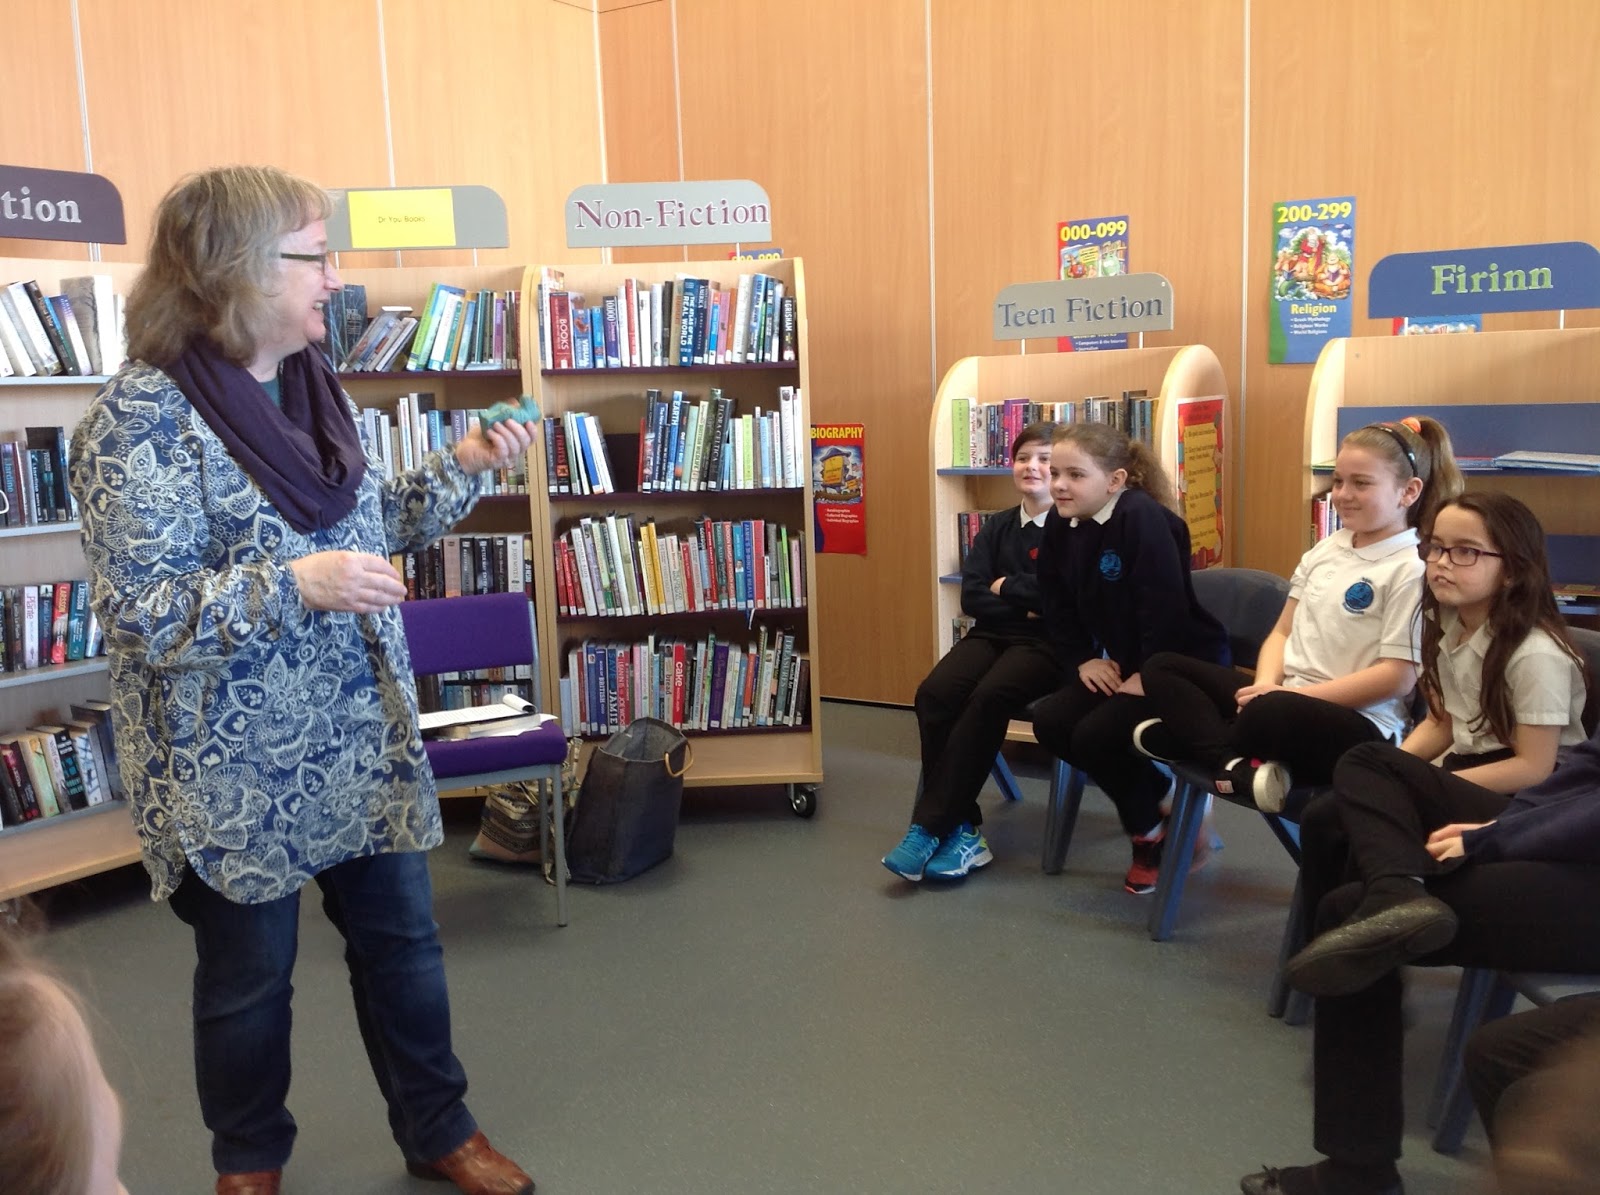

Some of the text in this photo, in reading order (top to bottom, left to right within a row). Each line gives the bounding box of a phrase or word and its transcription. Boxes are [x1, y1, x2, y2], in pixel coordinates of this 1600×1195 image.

[1, 186, 82, 223] tion
[573, 199, 770, 229] Non-Fiction
[1277, 201, 1352, 224] 200-299
[1060, 220, 1127, 242] 000-099
[1431, 263, 1554, 295] Firinn
[784, 303, 793, 332] GRISHAM
[998, 296, 1163, 328] Teen Fiction
[1291, 303, 1337, 317] Religion
[560, 319, 569, 350] BOOKS
[671, 400, 681, 426] EARTH
[713, 404, 725, 462] FLORA CELTICA
[811, 427, 863, 439] BIOGRAPHY
[58, 586, 67, 613] LARSSON
[76, 584, 86, 611] LARSSON
[675, 661, 684, 687] cake
[780, 639, 793, 688] TREASURES
[665, 674, 673, 695] bread
[609, 689, 617, 724] JAMIE
